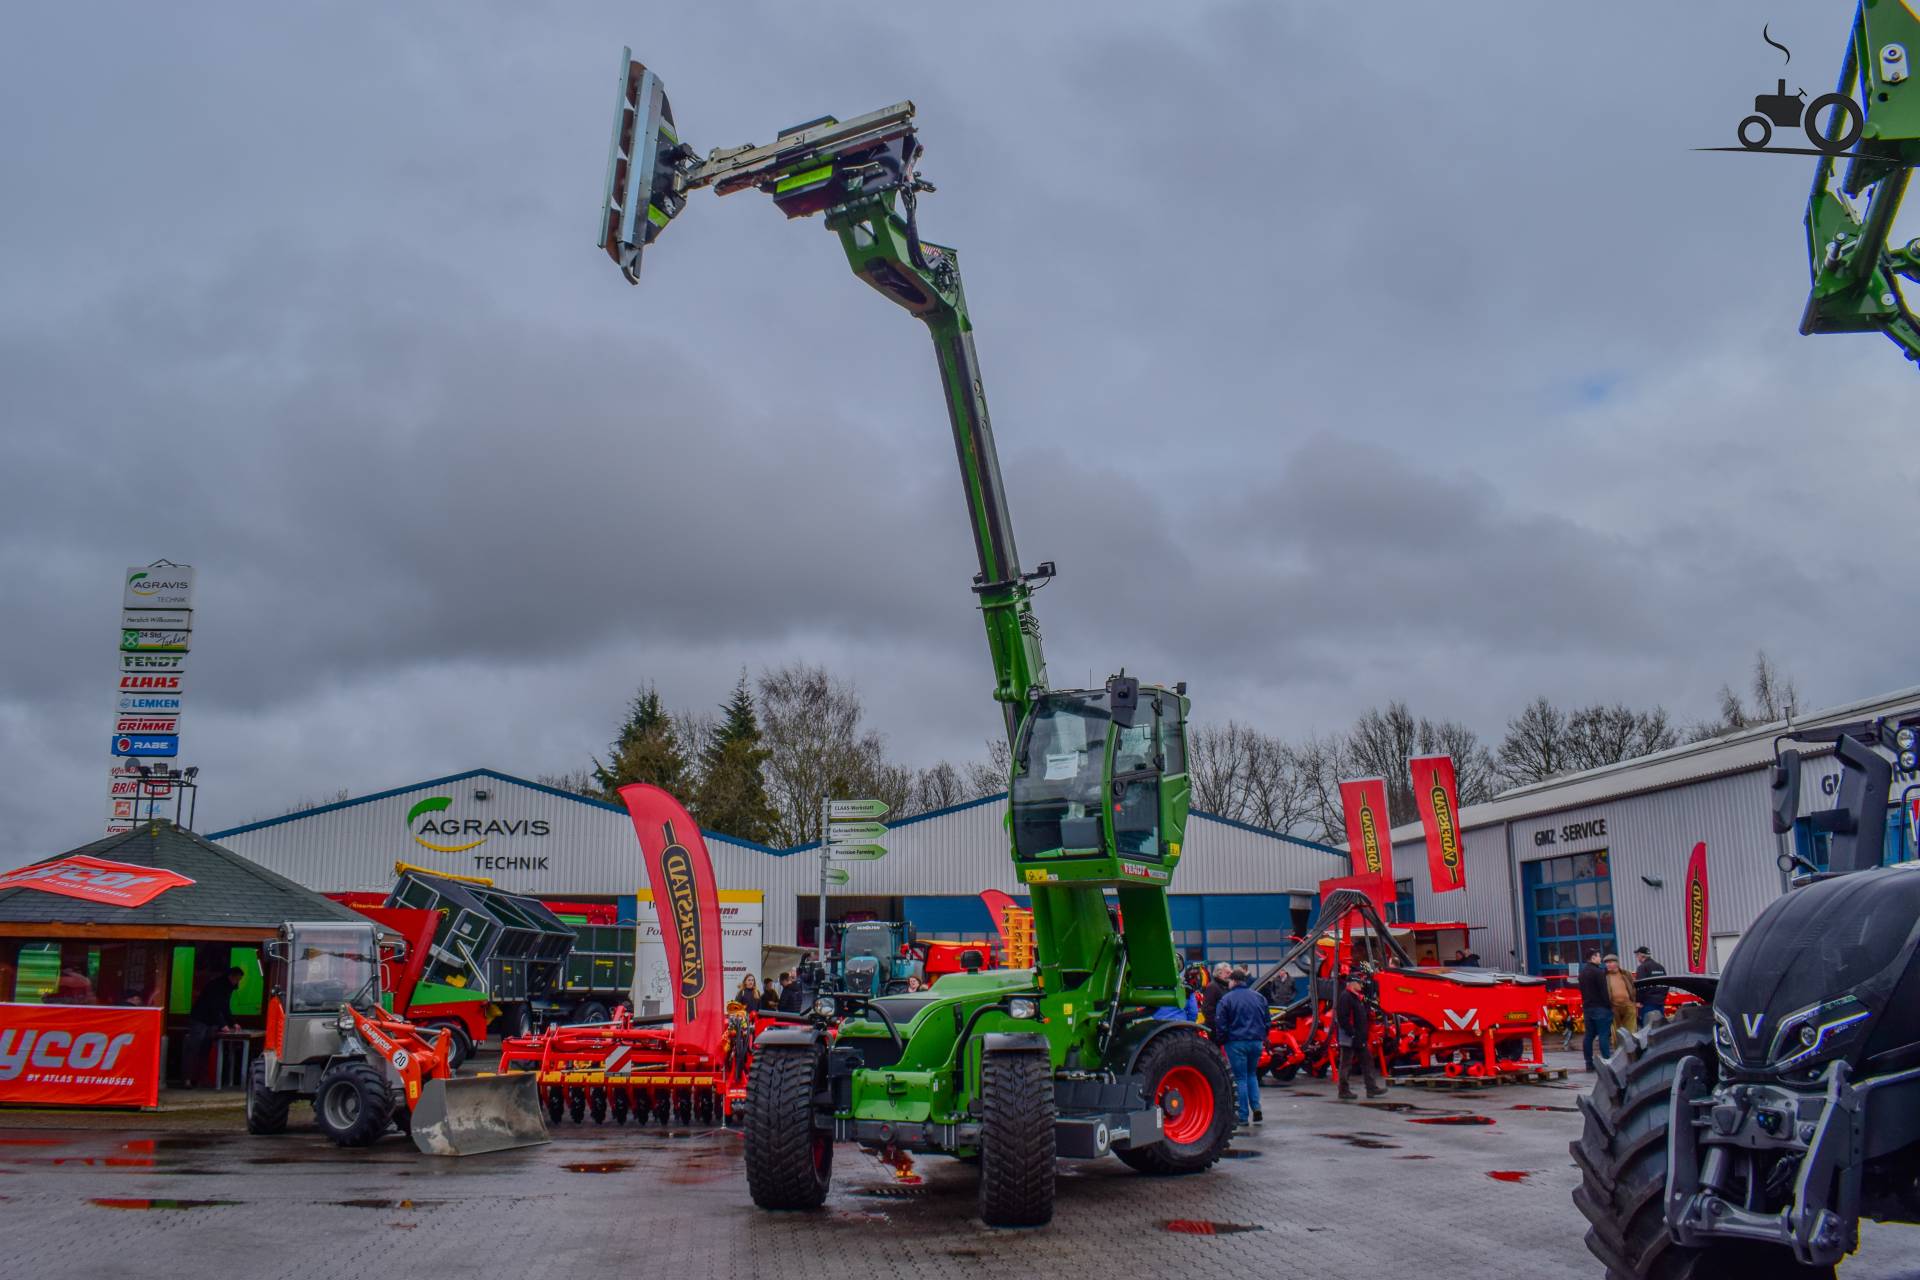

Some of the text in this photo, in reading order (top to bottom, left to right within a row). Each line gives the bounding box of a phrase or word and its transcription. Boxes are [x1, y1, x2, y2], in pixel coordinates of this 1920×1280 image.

[133, 581, 189, 589] AGRAVIS
[124, 656, 182, 667] FENDT
[120, 676, 180, 688] CLAAS
[132, 699, 179, 708] LEMKEN
[117, 721, 175, 731] GRIMME
[418, 819, 550, 835] AGRAVIS
[1535, 829, 1556, 846] GMZ
[474, 856, 549, 870] TECHNIK
[394, 1052, 407, 1067] 20
[27, 1073, 40, 1082] BY
[41, 1074, 73, 1084] ATLAS
